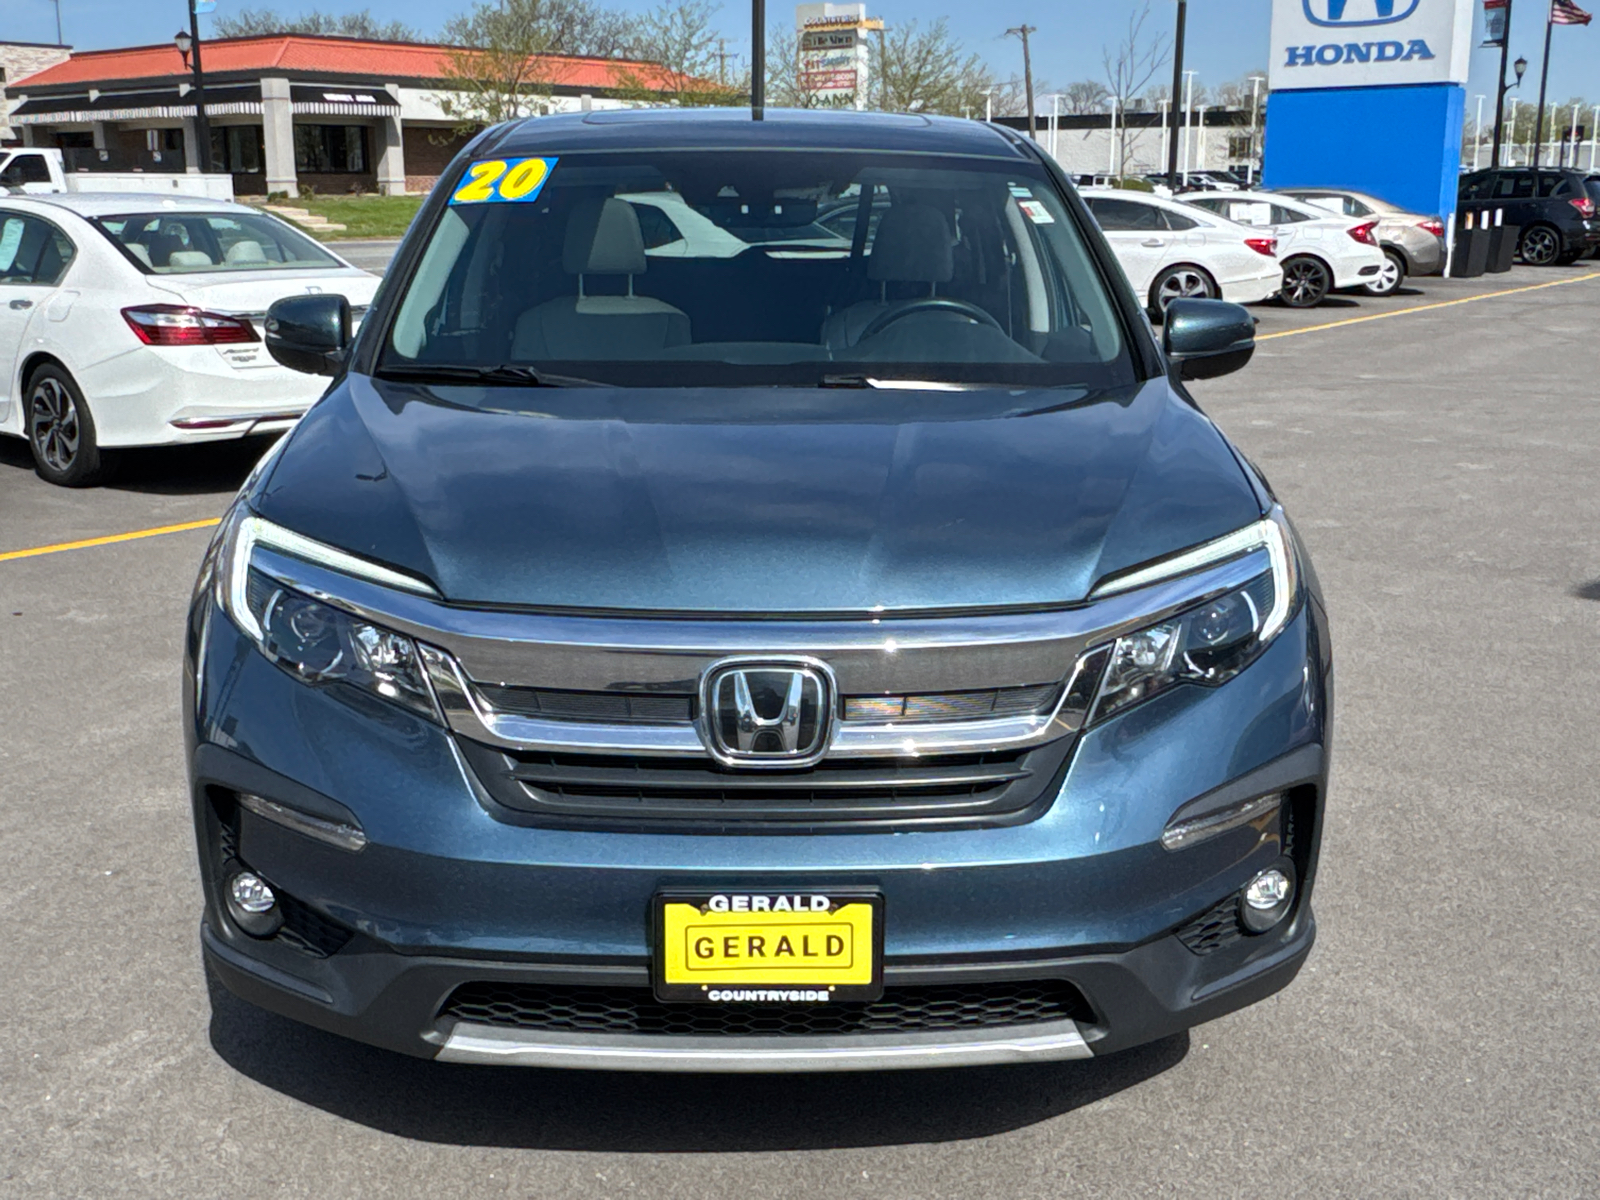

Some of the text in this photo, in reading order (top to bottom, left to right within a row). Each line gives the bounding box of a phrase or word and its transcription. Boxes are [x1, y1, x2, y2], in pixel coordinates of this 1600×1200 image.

[1284, 39, 1436, 67] HONDA
[453, 157, 548, 202] 20
[708, 894, 831, 912] GERALD
[694, 934, 845, 959] GERALD
[708, 990, 830, 1002] COUNTRYSIDE
